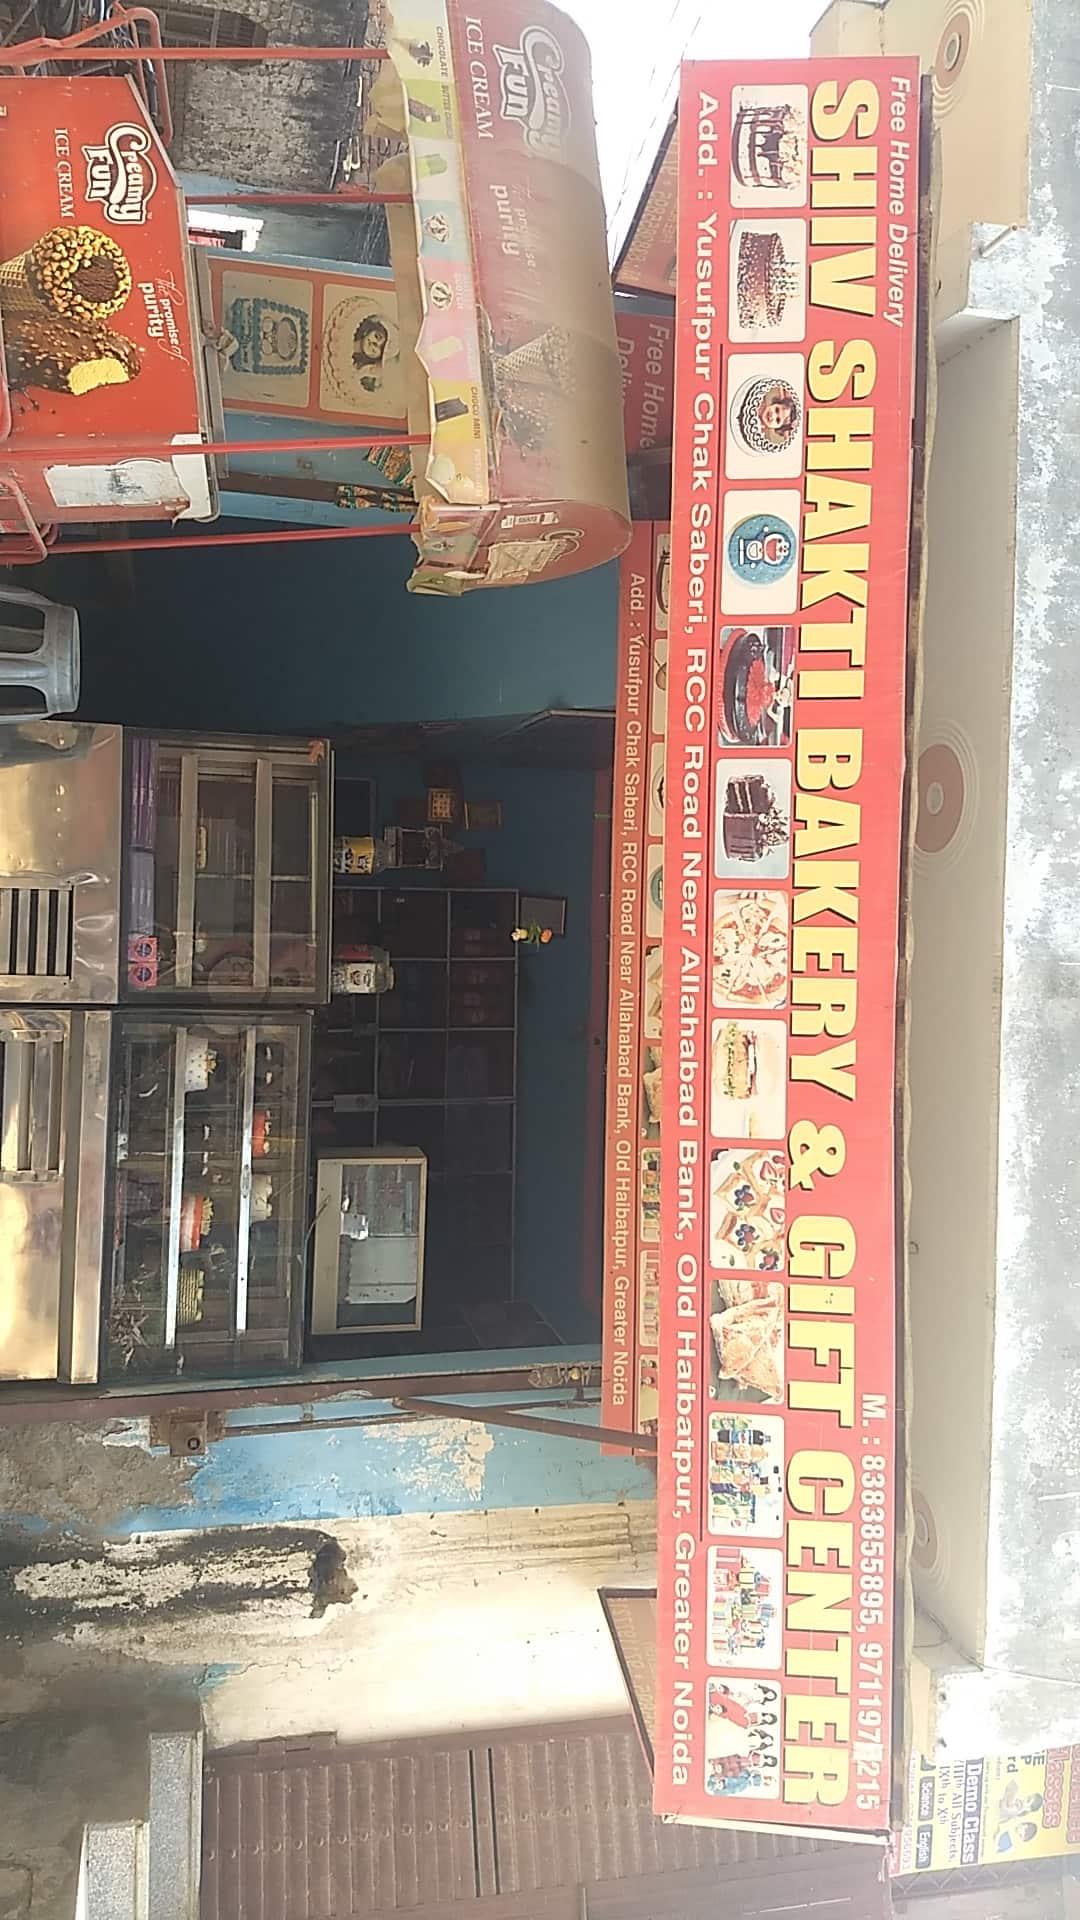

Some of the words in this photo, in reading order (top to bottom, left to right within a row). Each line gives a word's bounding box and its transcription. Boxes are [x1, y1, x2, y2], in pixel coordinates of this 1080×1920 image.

[435, 26, 449, 77] CHOCOLATE
[464, 15, 484, 55] ICE
[469, 61, 494, 139] CREAM
[498, 50, 530, 117] Fun
[524, 29, 563, 148] Creamy
[889, 76, 910, 131] Free
[54, 128, 71, 157] ICE
[84, 148, 114, 200] Fun
[106, 126, 150, 222] Creamy
[888, 140, 909, 214] Home
[57, 161, 76, 218] CREAM
[808, 79, 880, 317] SHIV
[137, 282, 165, 337] purity
[689, 213, 717, 382] Yusufpur
[884, 223, 908, 327] Delivery
[159, 298, 180, 345] promise
[645, 323, 670, 375] Free
[639, 382, 665, 449] Home
[691, 392, 714, 492] Chak
[796, 338, 876, 701] SHAKTI
[684, 502, 712, 636] Saberi,
[623, 633, 645, 715] Yusufpur
[683, 647, 705, 732] RCC
[625, 720, 642, 768] Chak
[621, 772, 641, 836] Saberi,
[681, 745, 704, 840] Road
[621, 841, 638, 883] RCC
[680, 852, 703, 937] Near
[620, 889, 636, 935] Road
[790, 728, 864, 1102] BAKERY
[619, 941, 635, 983] Near
[616, 988, 634, 1078] Allahabad
[678, 947, 701, 1127] Allahabad
[613, 1083, 632, 1134] Bank,
[614, 1140, 631, 1172] Old
[674, 1139, 699, 1240] Bank,
[787, 1119, 847, 1192] &
[610, 1177, 631, 1270] Haibatpur,
[612, 1276, 630, 1356] Greater
[676, 1253, 698, 1318] Old
[785, 1215, 857, 1428] GIFT
[612, 1361, 628, 1406] Noida
[669, 1330, 697, 1519] Haibatpur,
[857, 1454, 886, 1634] 8383855895,
[672, 1531, 696, 1669] Greater
[783, 1449, 856, 1806] CENTER
[671, 1680, 694, 1786] Noida
[853, 1642, 885, 1811] 971197215
[920, 1782, 933, 1817] Science
[938, 1793, 948, 1804] to
[951, 1792, 962, 1809] All
[965, 1764, 980, 1812] Demo
[916, 1831, 931, 1863] English
[961, 1816, 979, 1864] Class
